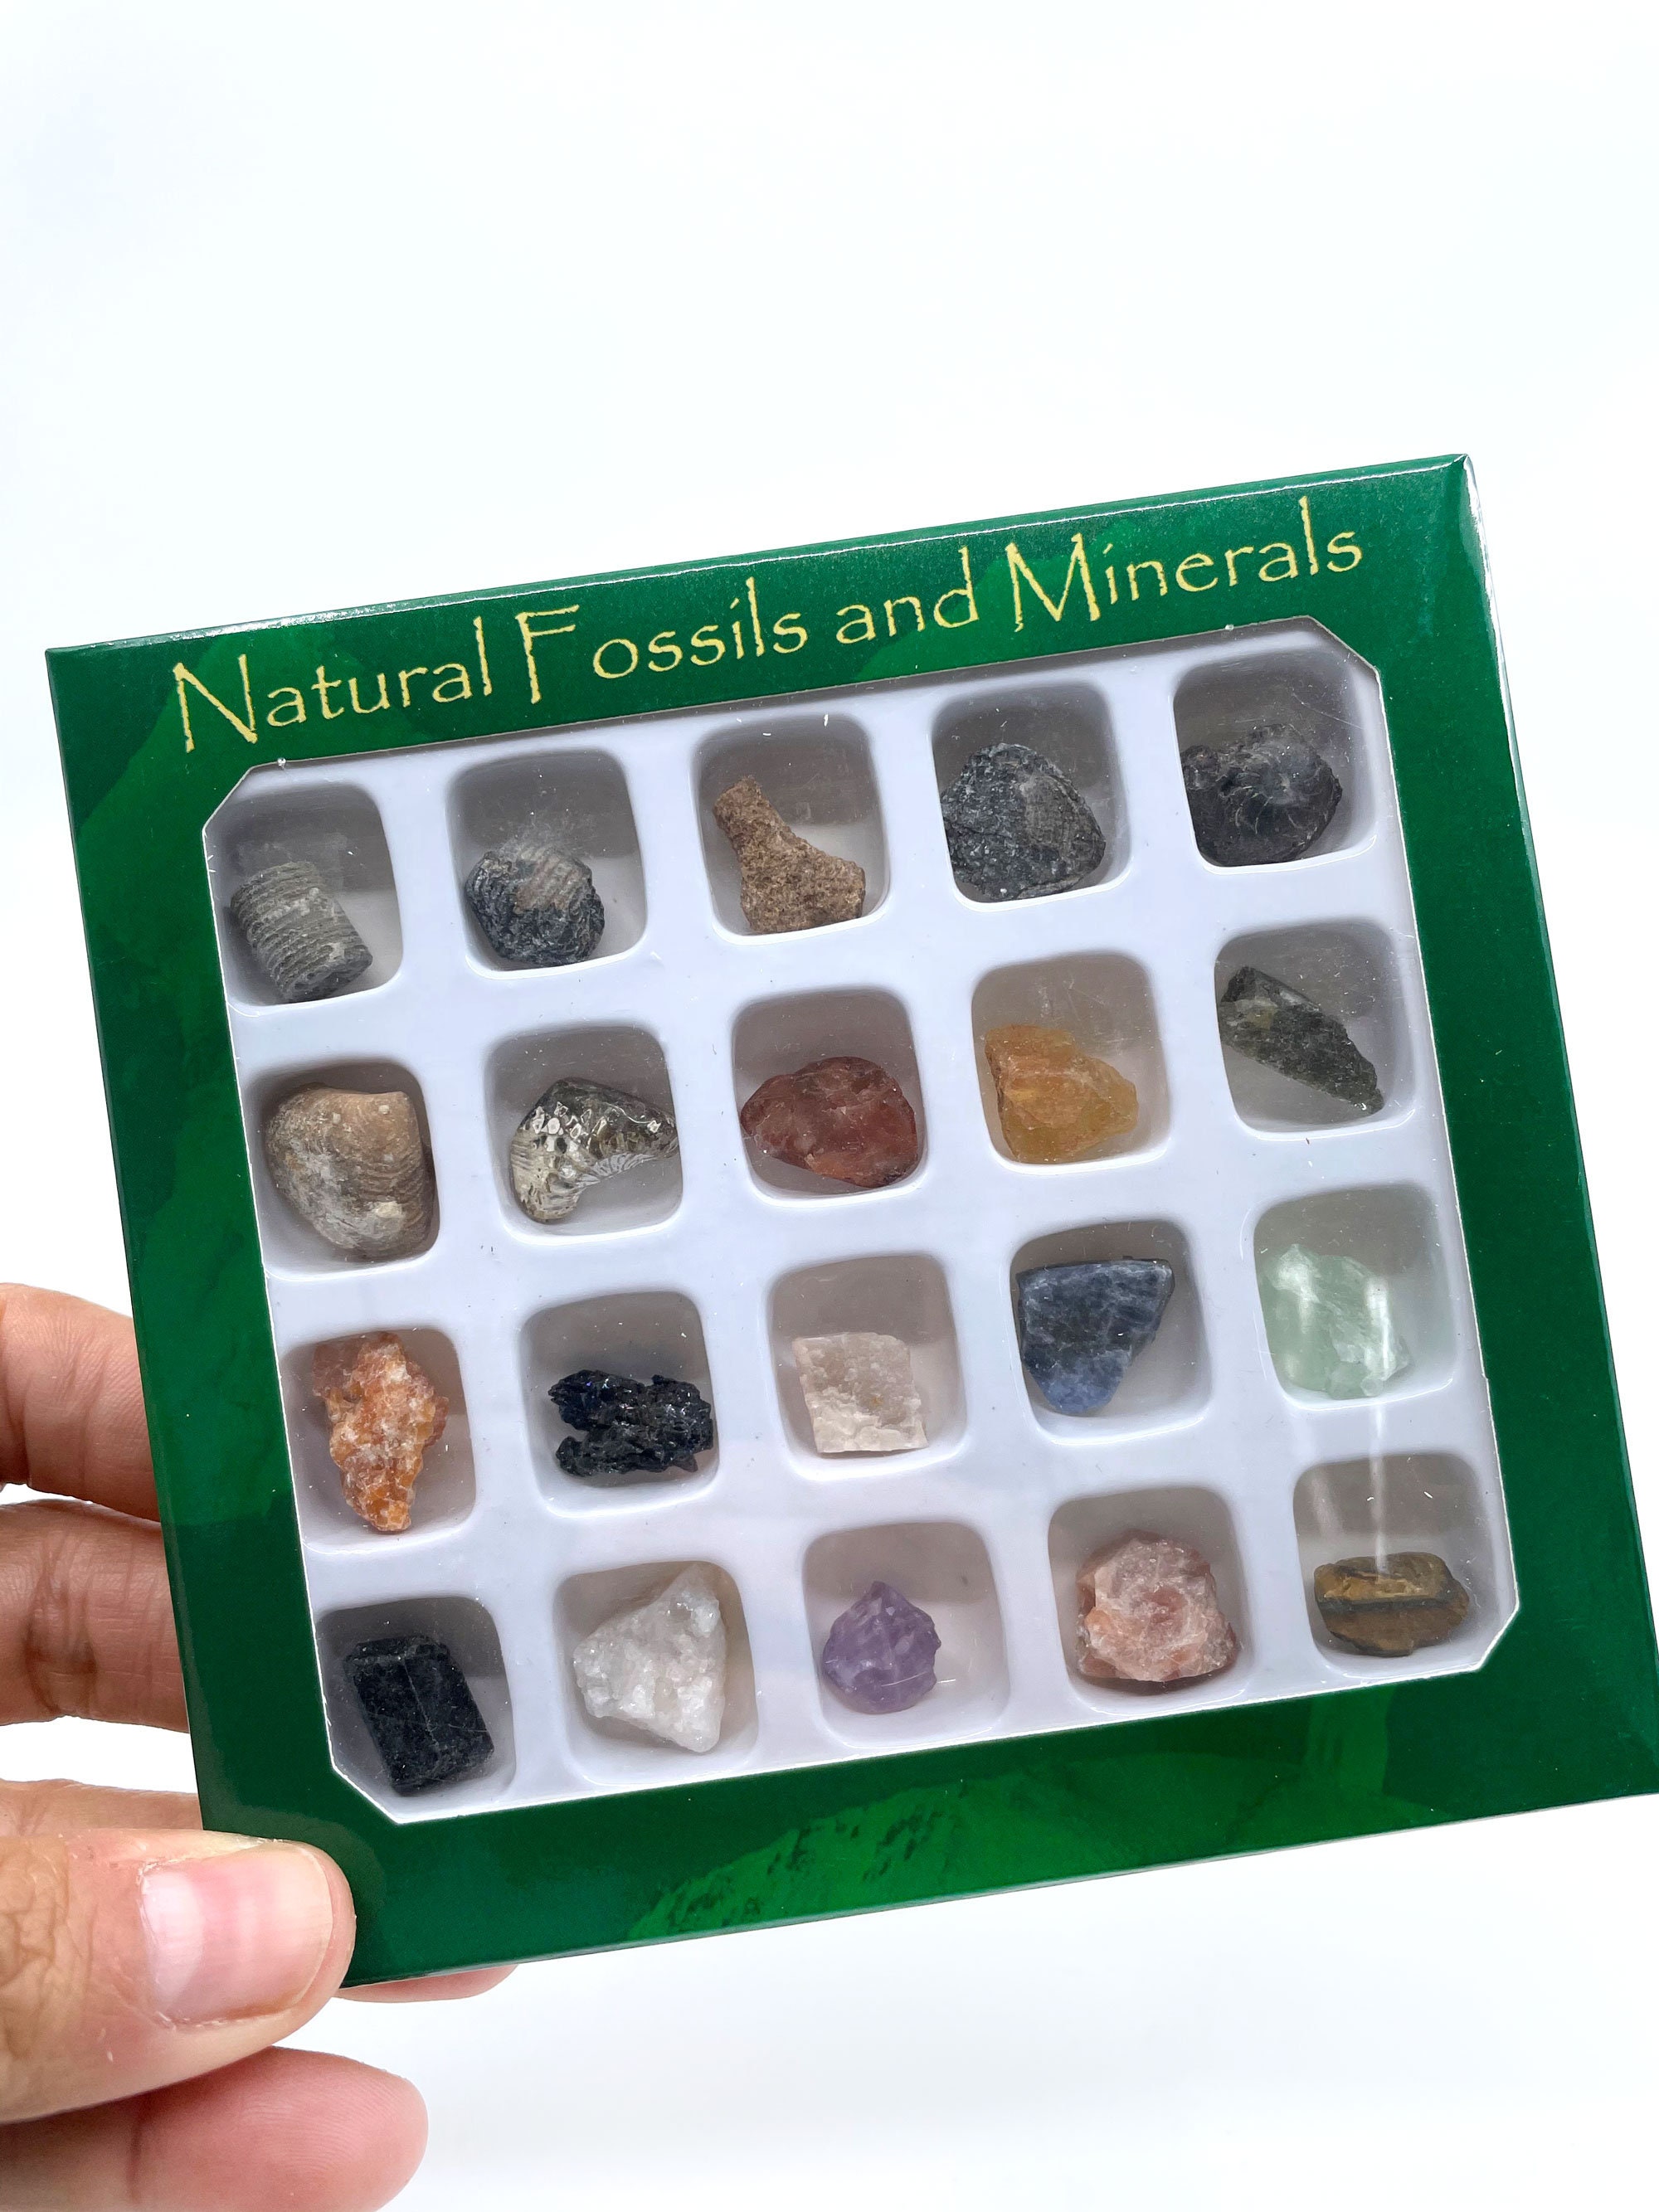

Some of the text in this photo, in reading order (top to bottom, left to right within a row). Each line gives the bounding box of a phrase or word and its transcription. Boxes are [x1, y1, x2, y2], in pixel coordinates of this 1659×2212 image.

[173, 496, 1364, 753] Natural Fossils and Minerals
